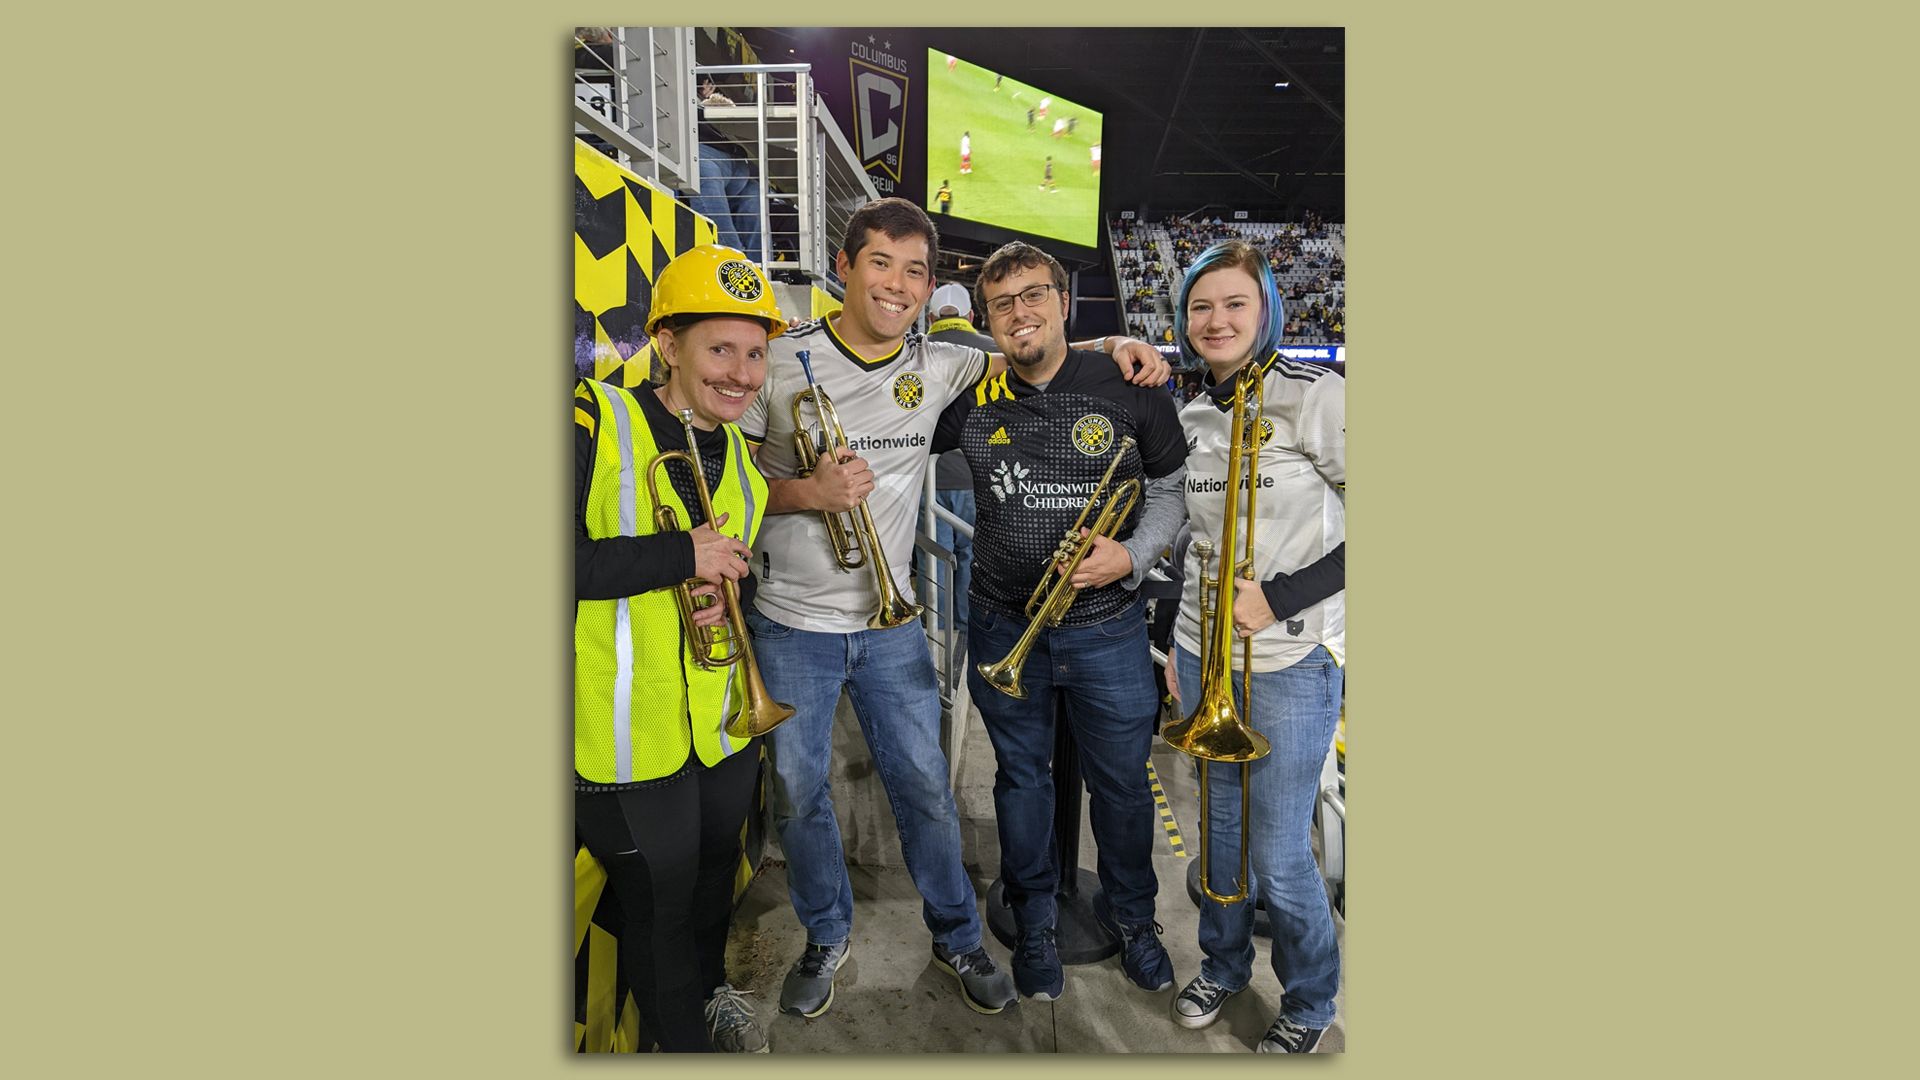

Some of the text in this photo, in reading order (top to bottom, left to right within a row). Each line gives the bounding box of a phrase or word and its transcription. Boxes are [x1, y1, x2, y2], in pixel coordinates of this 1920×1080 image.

[851, 41, 907, 73] COLUMBUS
[857, 72, 902, 161] C
[886, 153, 897, 166] 96
[721, 262, 758, 281] COLUMBUS
[724, 281, 748, 298] CREW
[895, 375, 922, 389] COLUMBUS
[896, 395, 911, 408] CREW
[1077, 418, 1109, 433] COLUMBUS
[835, 432, 926, 451] ationwide
[1078, 438, 1108, 451] CREW SC
